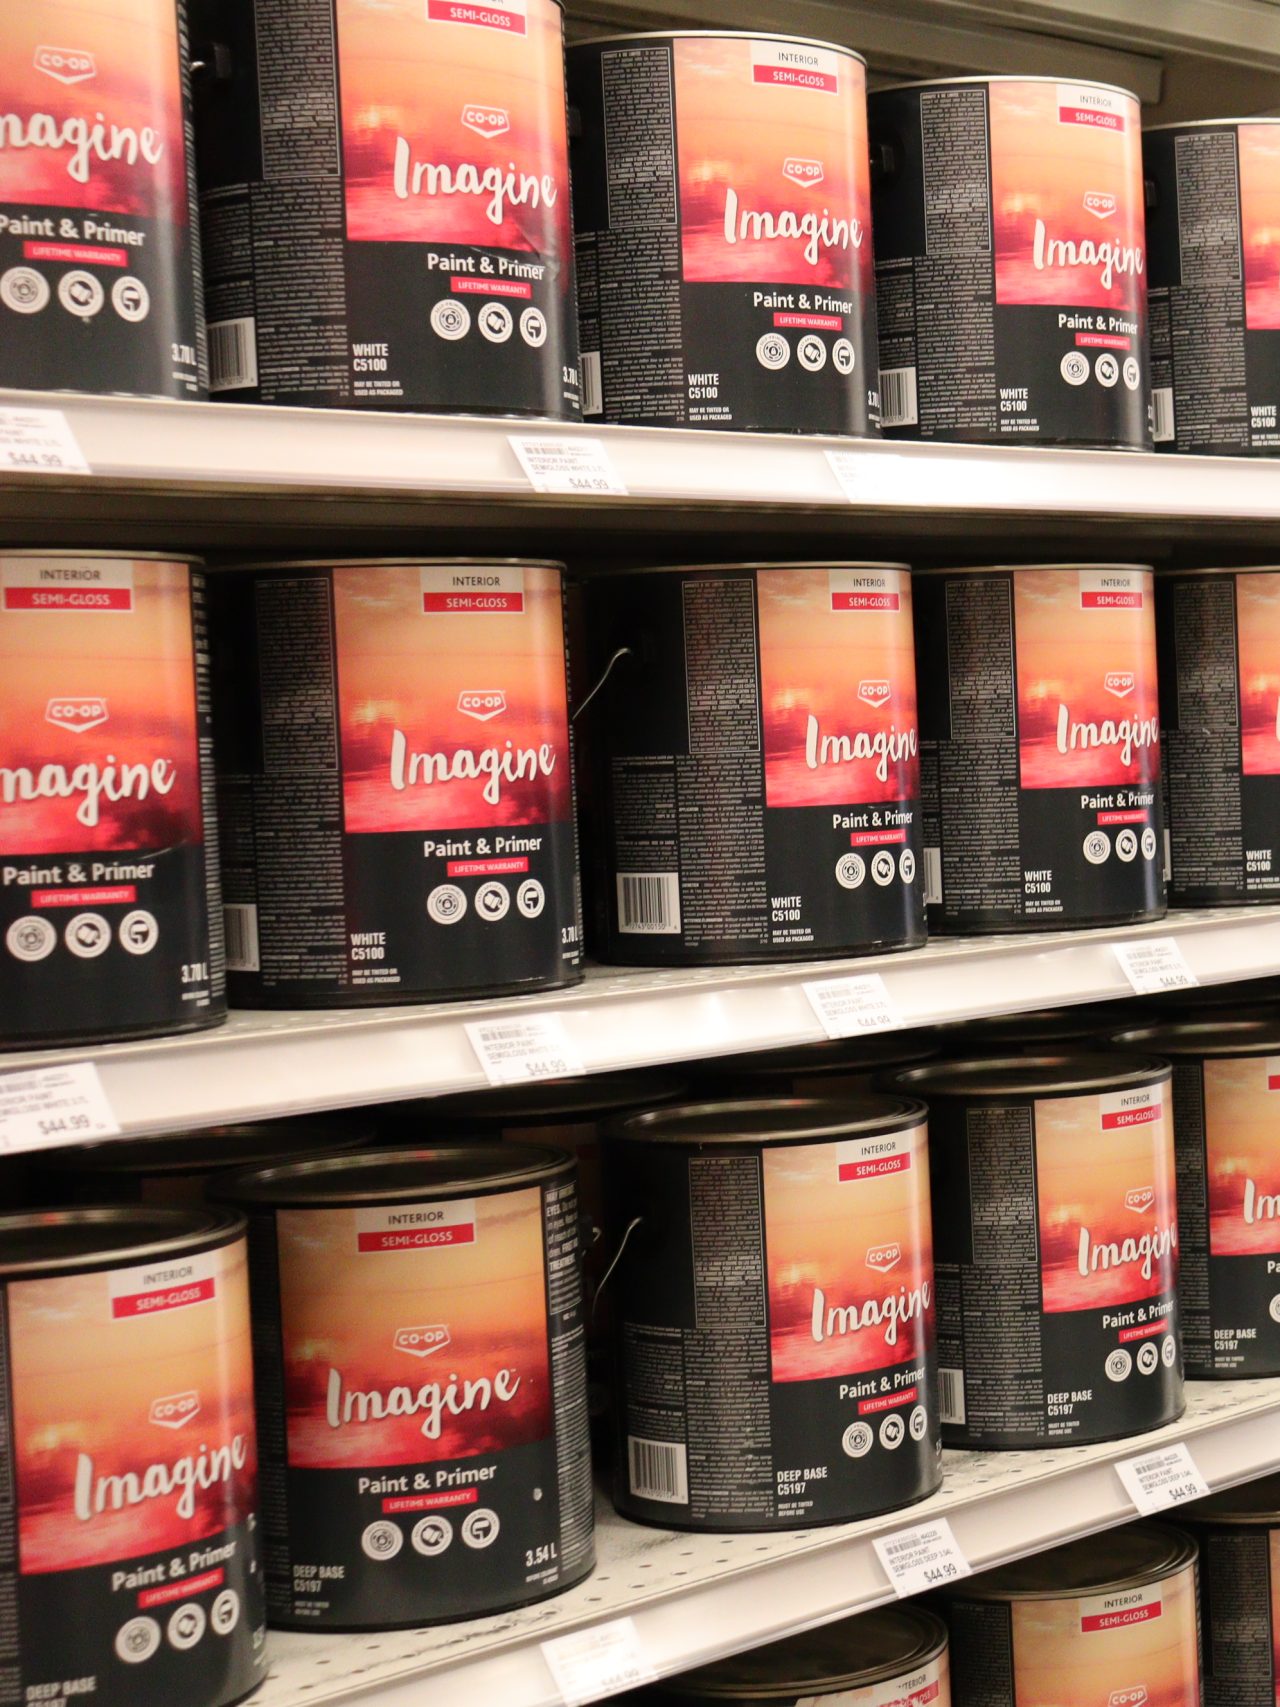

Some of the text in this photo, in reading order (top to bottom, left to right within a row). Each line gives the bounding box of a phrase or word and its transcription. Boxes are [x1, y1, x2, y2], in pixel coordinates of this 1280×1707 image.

[450, 7, 511, 27] SEMI-GLOSS
[40, 53, 91, 70] CO-OP
[778, 52, 819, 67] INTERIOR
[773, 70, 825, 88] SEMI-GLOSS
[466, 110, 505, 126] CO-OP
[1075, 112, 1117, 127] SEMI-GLOSS
[0, 112, 164, 183] magine
[787, 163, 820, 178] CO-OP
[393, 136, 557, 225] Imagine
[0, 214, 146, 246] Paint & Primer
[724, 188, 863, 265] Imagine
[1033, 219, 1143, 290] Imagine
[427, 253, 545, 281] Paint & Primer
[753, 292, 853, 315] Paint & Primer
[1058, 313, 1138, 335] Paint & Primer
[352, 343, 388, 357] WHITE
[353, 358, 388, 372] C5100
[688, 374, 719, 386] WHITE
[688, 387, 718, 399] C5100
[1000, 388, 1028, 400] WHITE
[1000, 400, 1027, 412] C5100
[1251, 406, 1276, 417] WHITE
[39, 569, 101, 581] INTERIOR
[452, 576, 500, 587] INTERIOR
[853, 578, 886, 588] INTERIOR
[32, 592, 110, 606] SEMI-GLOSS
[447, 598, 508, 609] SEMI-GLOSS
[848, 597, 891, 607] SEMI-GLOSS
[861, 685, 888, 697] CO-OP
[463, 696, 501, 708] CO-OP
[51, 704, 101, 718] CO-OP
[1056, 704, 1158, 766] Imagine
[805, 714, 917, 783] Imagine
[390, 729, 556, 805] Imagine
[0, 754, 176, 827] magine
[1081, 792, 1154, 810] Paint & Primer
[833, 810, 913, 829] Paint & Primer
[424, 835, 542, 857] Paint & Primer
[1246, 850, 1272, 861] WHITE
[3, 862, 155, 886] Paint & Primer
[454, 861, 524, 873] LIFETIME WARRANTY
[1025, 870, 1052, 882] WHITE
[1025, 882, 1051, 894] C5100
[771, 896, 801, 908] WHITE
[772, 909, 800, 922] C5100
[351, 932, 386, 946] WHITE
[351, 947, 385, 961] C5100
[525, 1059, 567, 1076] $44.99
[1117, 1110, 1154, 1125] SEMI-GLOSS
[861, 1142, 896, 1156] INTERIOR
[856, 1159, 901, 1176] SEMI-GLOSS
[1128, 1191, 1151, 1205] CO-OP
[388, 1211, 444, 1225] INTERIOR
[381, 1231, 453, 1247] SEMI-GLOSS
[869, 1248, 898, 1262] CO-OP
[1078, 1223, 1176, 1280] Imagine
[811, 1281, 930, 1345] Imagine
[1102, 1301, 1174, 1329] Paint & Primer
[399, 1330, 445, 1345] CO-OP
[1214, 1328, 1256, 1339] DEEP BASE
[839, 1367, 925, 1400] Paint & Primer
[327, 1368, 520, 1440] Imagine
[1047, 1389, 1092, 1404] DEEP BASE
[1047, 1404, 1073, 1416] C5197
[74, 1434, 247, 1520] Imagine
[358, 1465, 497, 1495] Paint & Primer
[777, 1466, 827, 1483] DEEP BASE
[778, 1482, 806, 1496] C5197
[1169, 1483, 1198, 1500] $44.99
[525, 1542, 558, 1567] 3.54 L
[112, 1541, 237, 1592] Paint & Primer
[924, 1563, 957, 1582] $44.99
[1104, 1594, 1143, 1608] INTERIOR
[1099, 1609, 1149, 1627] SEMI-GLOSS
[897, 1674, 926, 1690] TERIOR
[1112, 1690, 1144, 1705] CO-OP
